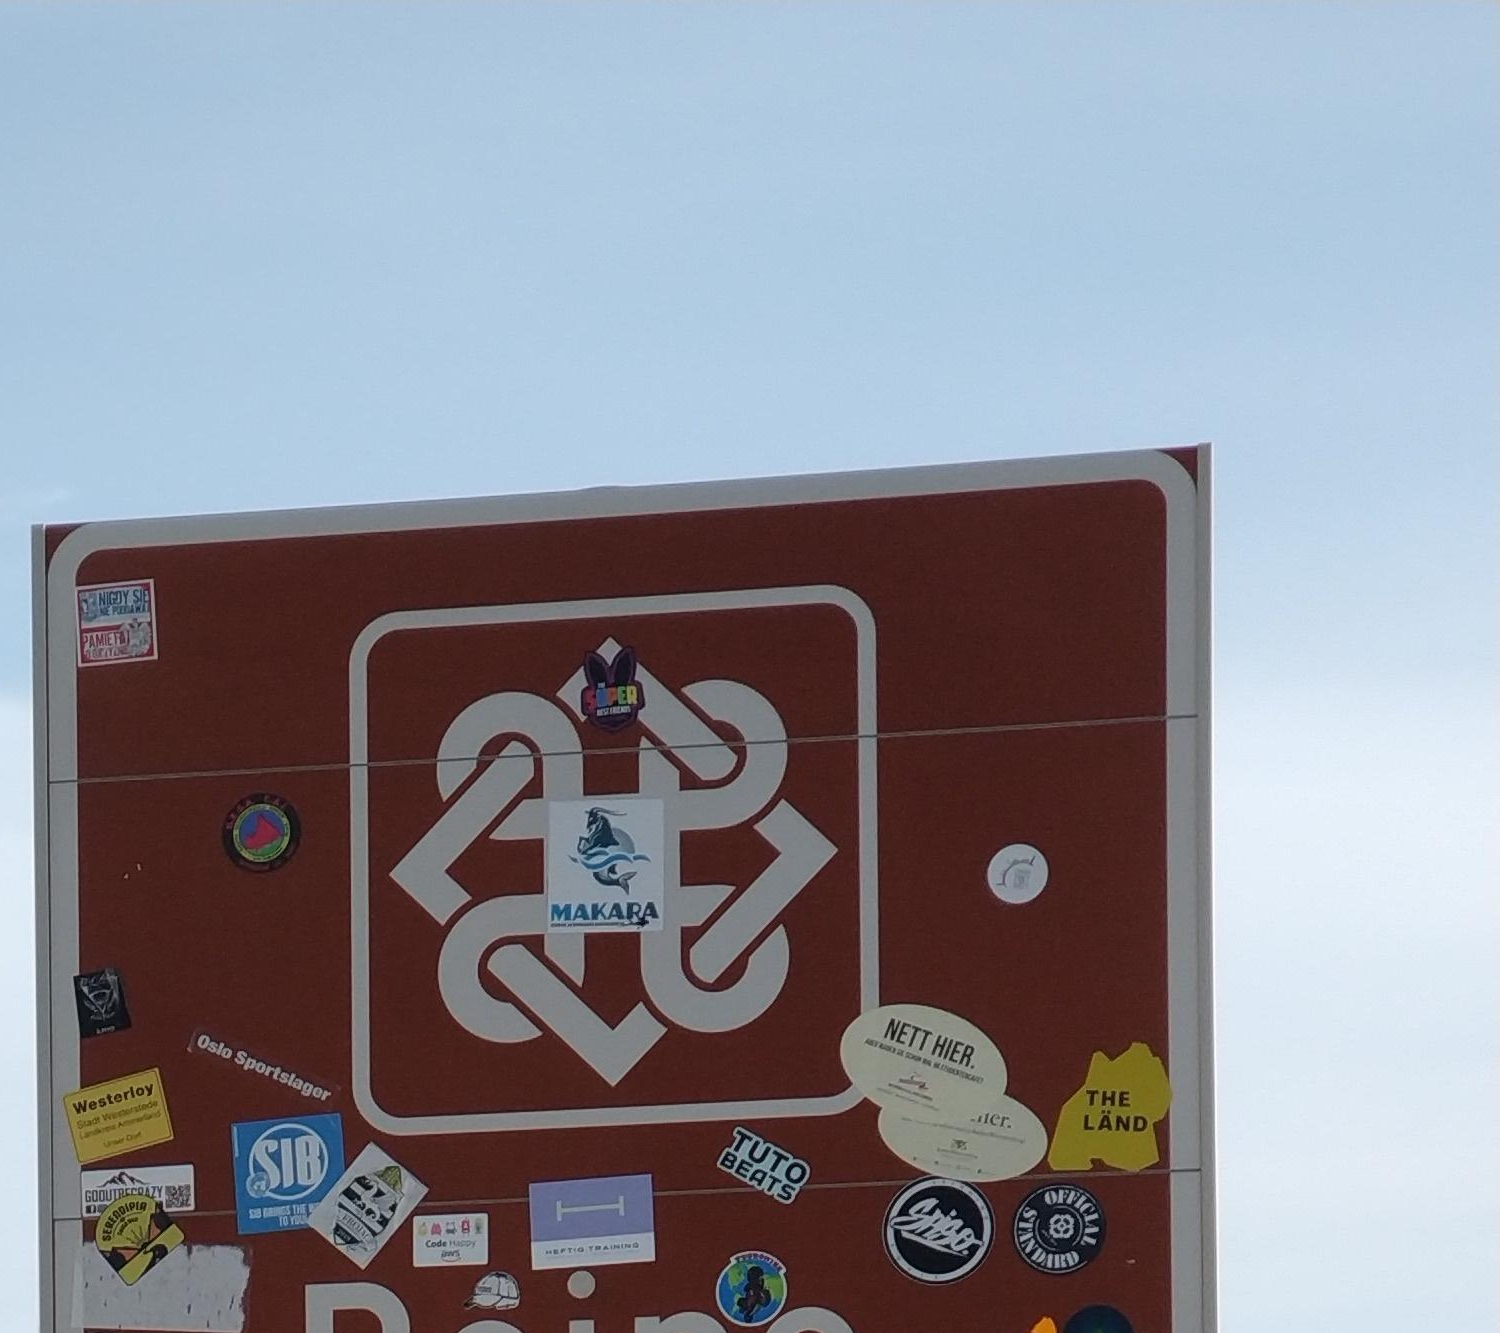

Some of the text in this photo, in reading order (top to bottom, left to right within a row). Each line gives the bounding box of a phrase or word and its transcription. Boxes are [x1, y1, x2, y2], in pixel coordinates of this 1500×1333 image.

[550, 901, 659, 922] MAKARA
[197, 1034, 331, 1100] Oslo Sportslager
[884, 1018, 975, 1070] NETT HIER.
[72, 1083, 154, 1115] Westerloy
[1083, 1110, 1148, 1132] LÄND
[1086, 1090, 1131, 1107] THE
[254, 1136, 322, 1188] SIB
[719, 1152, 796, 1202] BEATS
[733, 1128, 809, 1184] TUTO
[1017, 1205, 1080, 1269] STANDARD
[1044, 1188, 1100, 1246] OFFICIAL
[425, 1239, 447, 1249] Code
[598, 1241, 639, 1252] TRAINING
